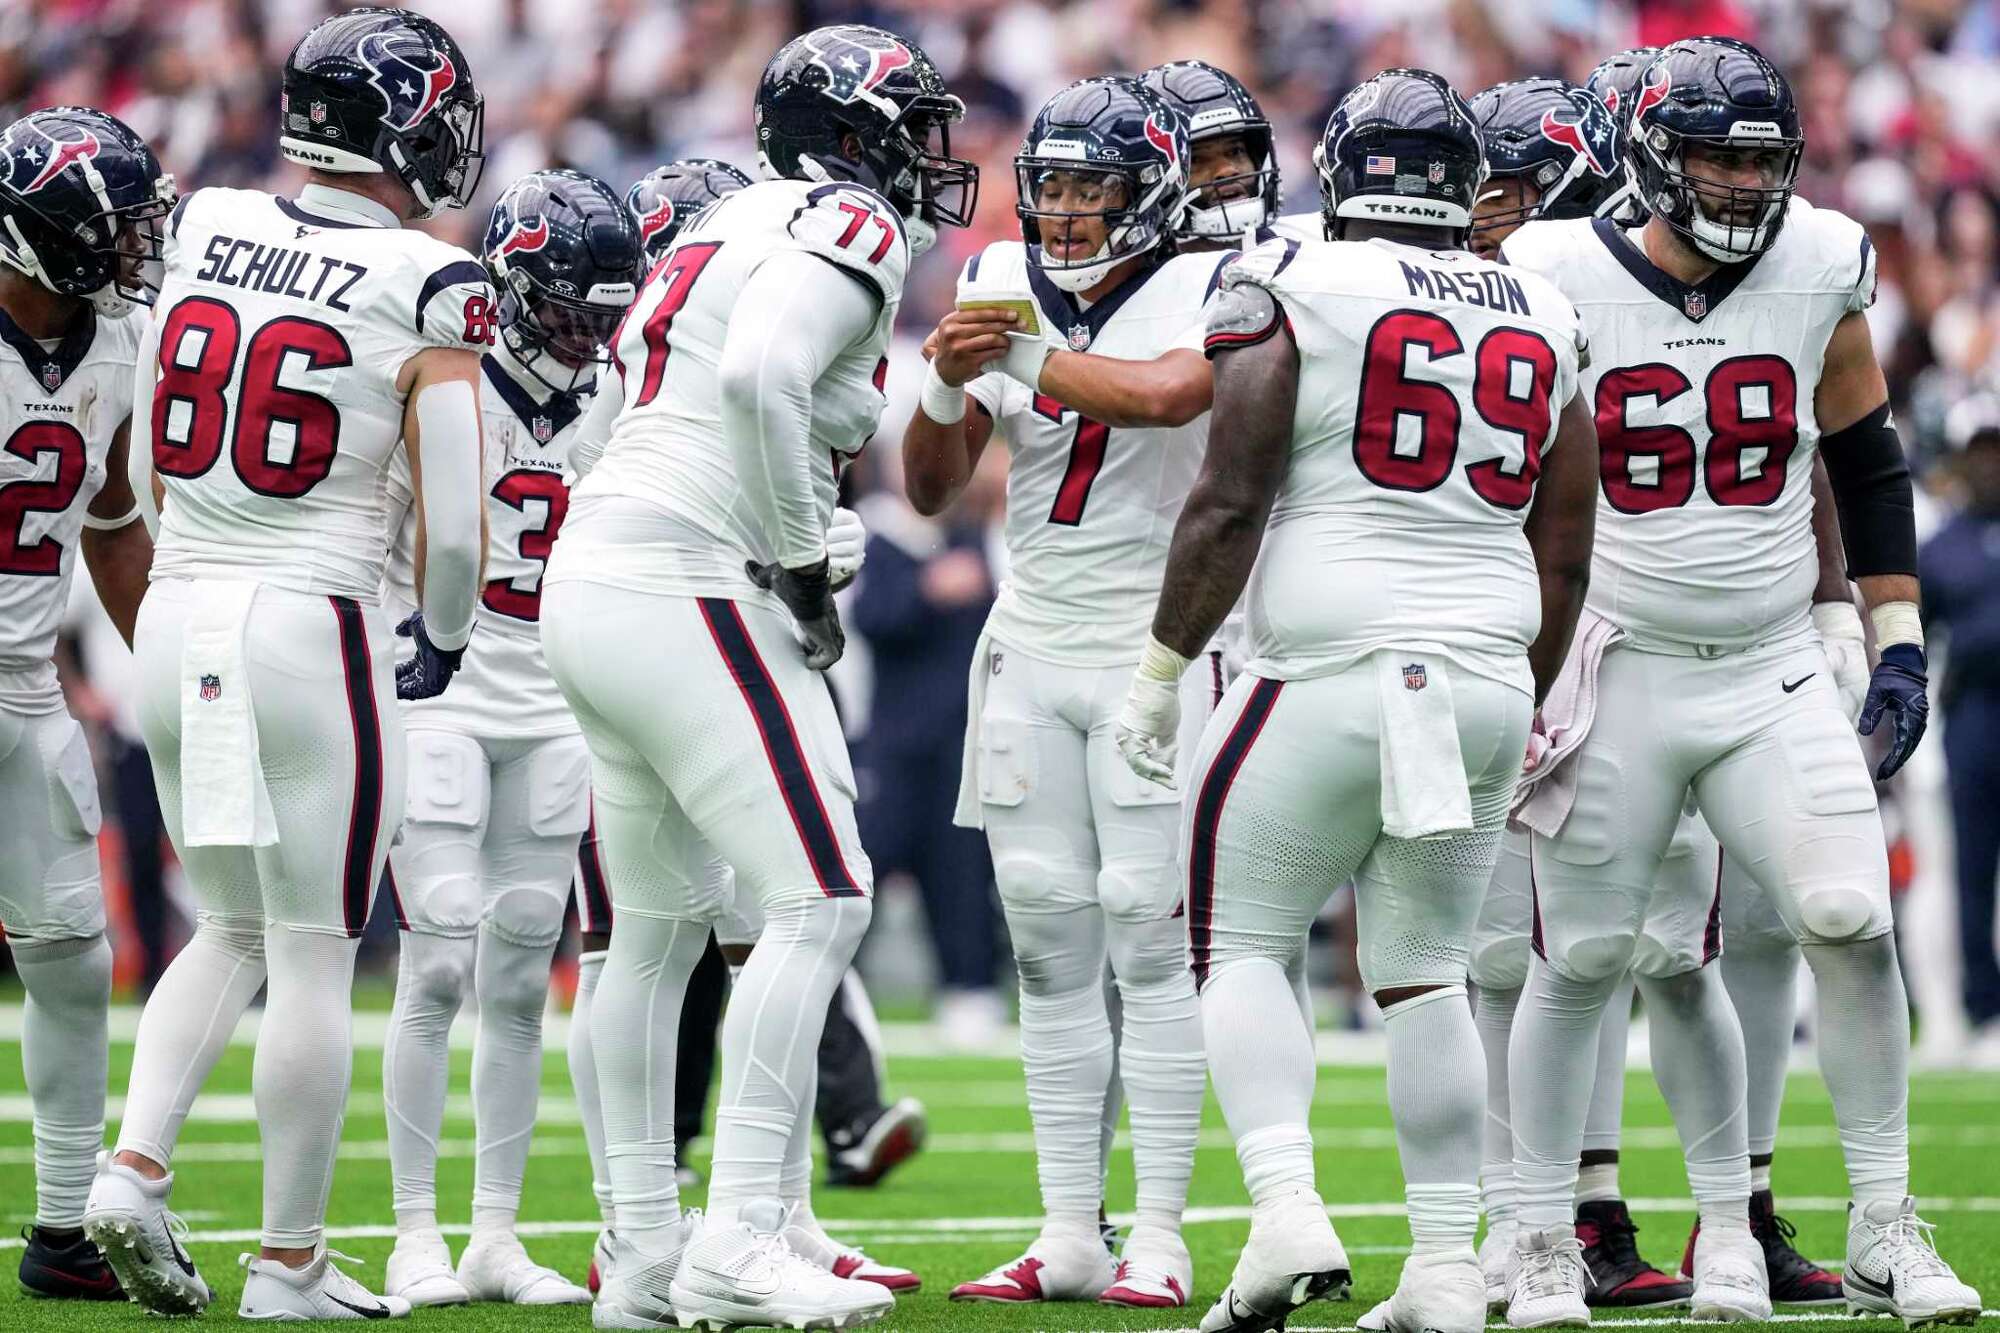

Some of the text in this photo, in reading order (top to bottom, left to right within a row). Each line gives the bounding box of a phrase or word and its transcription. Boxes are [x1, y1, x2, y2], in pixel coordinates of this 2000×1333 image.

[281, 146, 334, 163] TEXANS
[839, 201, 896, 265] 77
[1365, 203, 1448, 218] TEXANS
[197, 235, 368, 312] SCHULTZ
[1399, 261, 1531, 316] MASON
[1663, 337, 1726, 350] TEXANS
[24, 403, 74, 413] TEXANS
[152, 295, 353, 498] 86
[1352, 308, 1557, 511] 69
[511, 456, 563, 470] TEXANS
[1032, 391, 1110, 526] 7
[1594, 354, 1799, 515] 68
[0, 420, 86, 576] 2
[481, 469, 568, 622] 3
